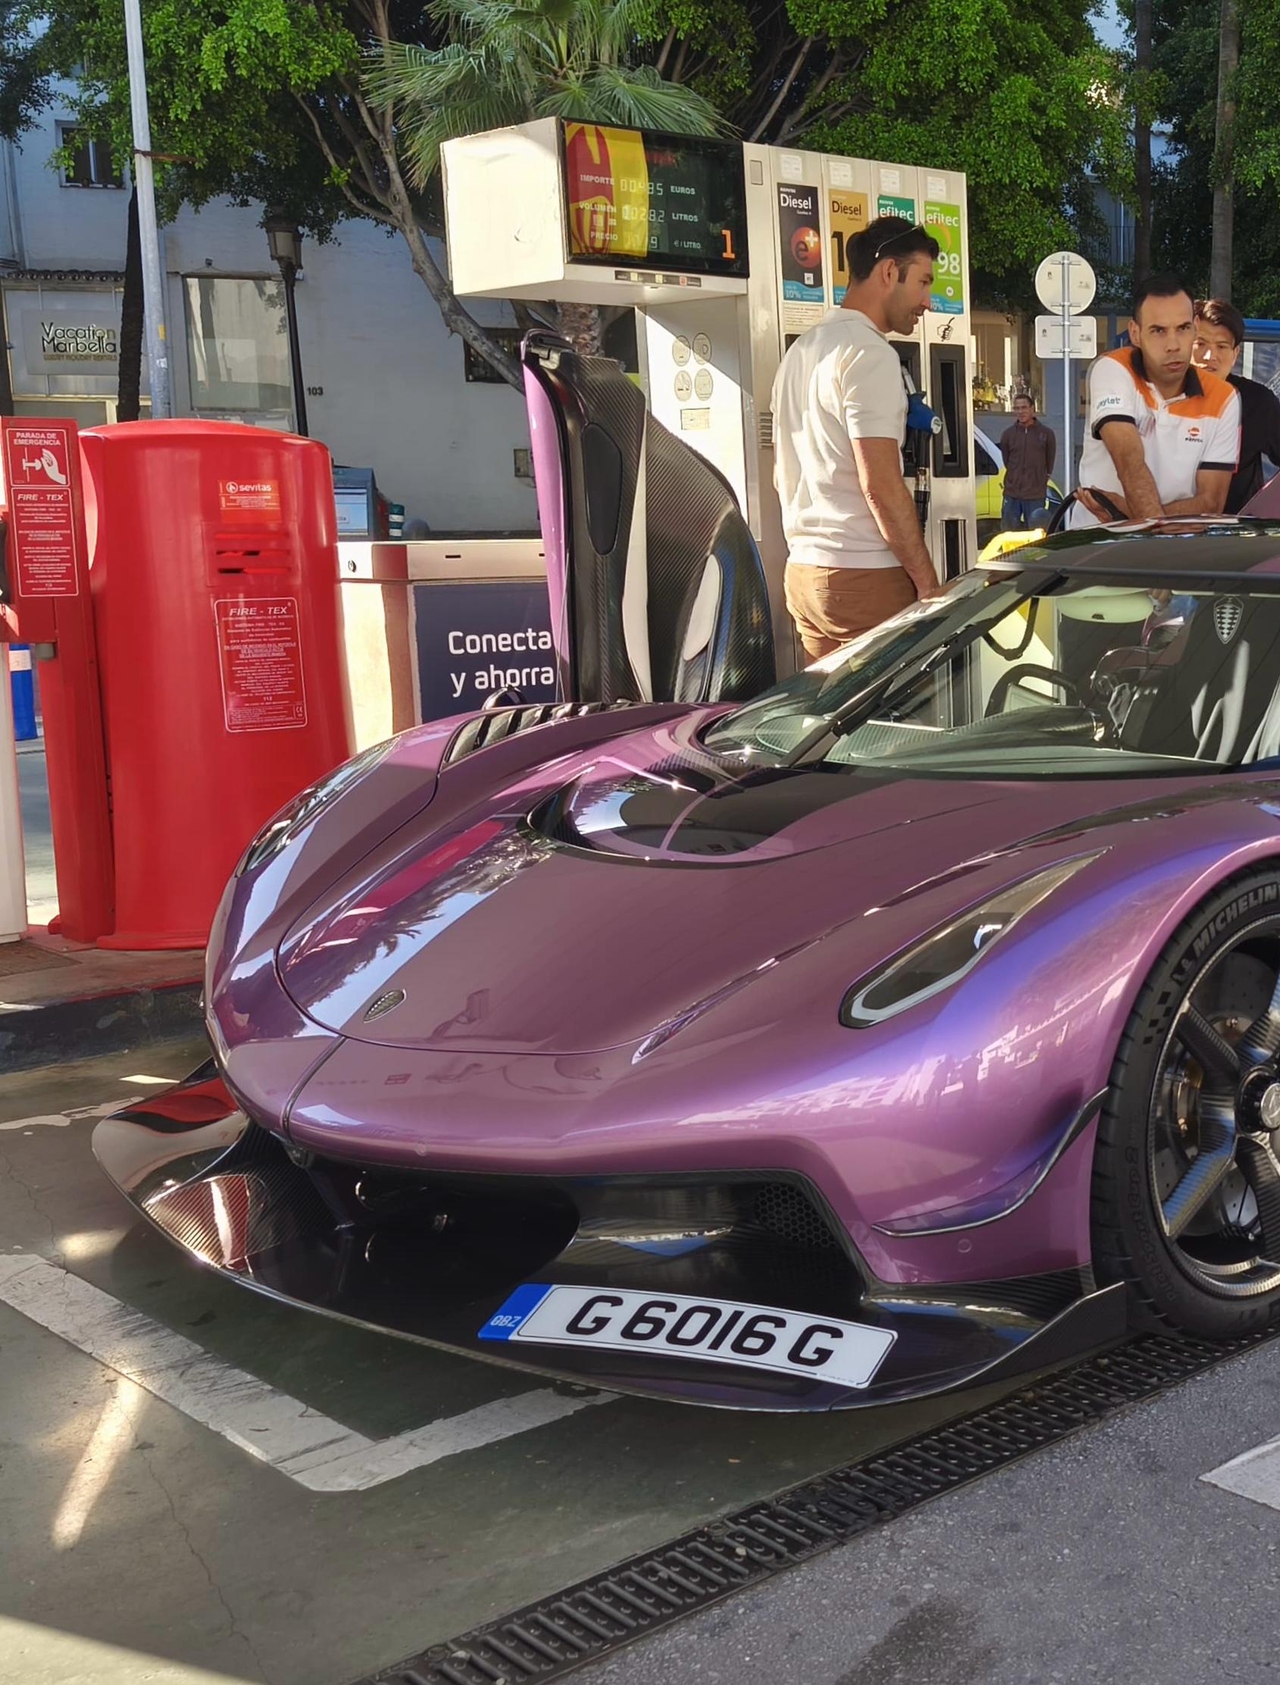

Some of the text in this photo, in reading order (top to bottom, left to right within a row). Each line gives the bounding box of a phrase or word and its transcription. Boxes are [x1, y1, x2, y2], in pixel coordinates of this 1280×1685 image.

[580, 174, 615, 186] IMPORTE
[670, 185, 696, 195] EUROS
[780, 193, 812, 210] Diesel
[832, 200, 862, 216] Diesel
[579, 202, 617, 213] VOLUMEN
[672, 213, 699, 222] LITROS
[880, 206, 914, 221] efitec
[926, 212, 959, 227] efitec
[591, 231, 618, 241] PRECIO
[722, 229, 736, 259] 1
[937, 251, 960, 275] 98
[41, 321, 116, 340] Vacation
[41, 335, 117, 353] Marbella
[307, 387, 323, 396] 103
[13, 438, 61, 446] EMERGENCIA
[239, 483, 272, 492] sevitas
[229, 607, 257, 616] FIRE
[267, 606, 288, 615] TEX
[448, 628, 552, 655] Conecta
[450, 664, 555, 698] y ahorra
[1192, 883, 1279, 959] MICHELIN
[565, 1295, 845, 1368] G 6016 G
